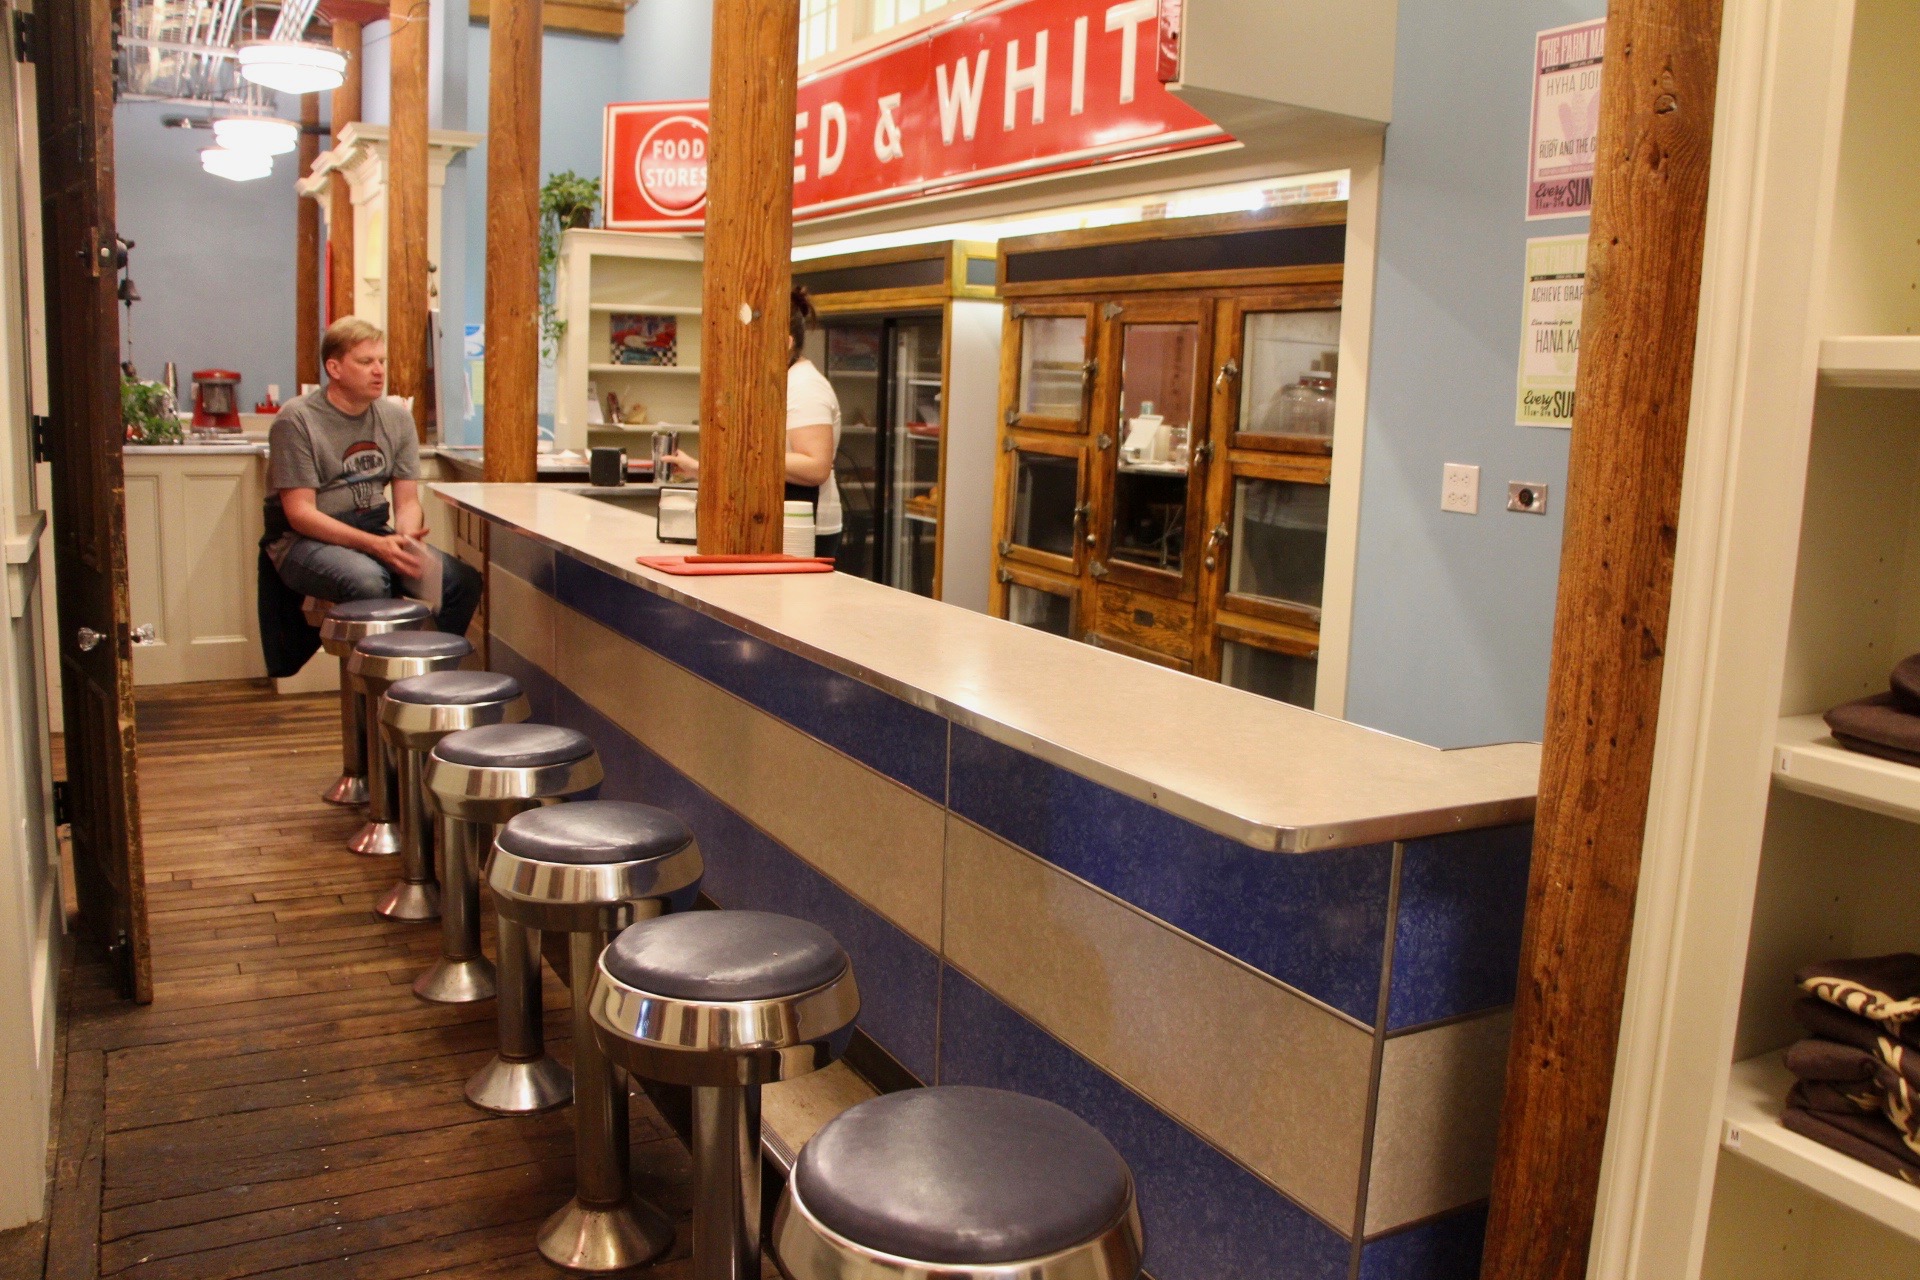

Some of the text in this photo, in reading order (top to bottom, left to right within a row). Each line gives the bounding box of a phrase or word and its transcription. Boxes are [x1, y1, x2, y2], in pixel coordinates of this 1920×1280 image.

[1541, 37, 1560, 67] THE
[1561, 31, 1588, 64] FARM
[1547, 74, 1575, 96] HYHA
[874, 92, 903, 163] &
[653, 138, 705, 160] FOOD
[1559, 139, 1574, 156] AND
[1576, 136, 1588, 154] THE
[645, 166, 708, 188] STORES
[1535, 182, 1567, 201] Every
[1531, 286, 1561, 302] ACHIEVE
[1535, 329, 1563, 353] HANA
[1524, 389, 1553, 411] Every
[1730, 1129, 1739, 1141] M
